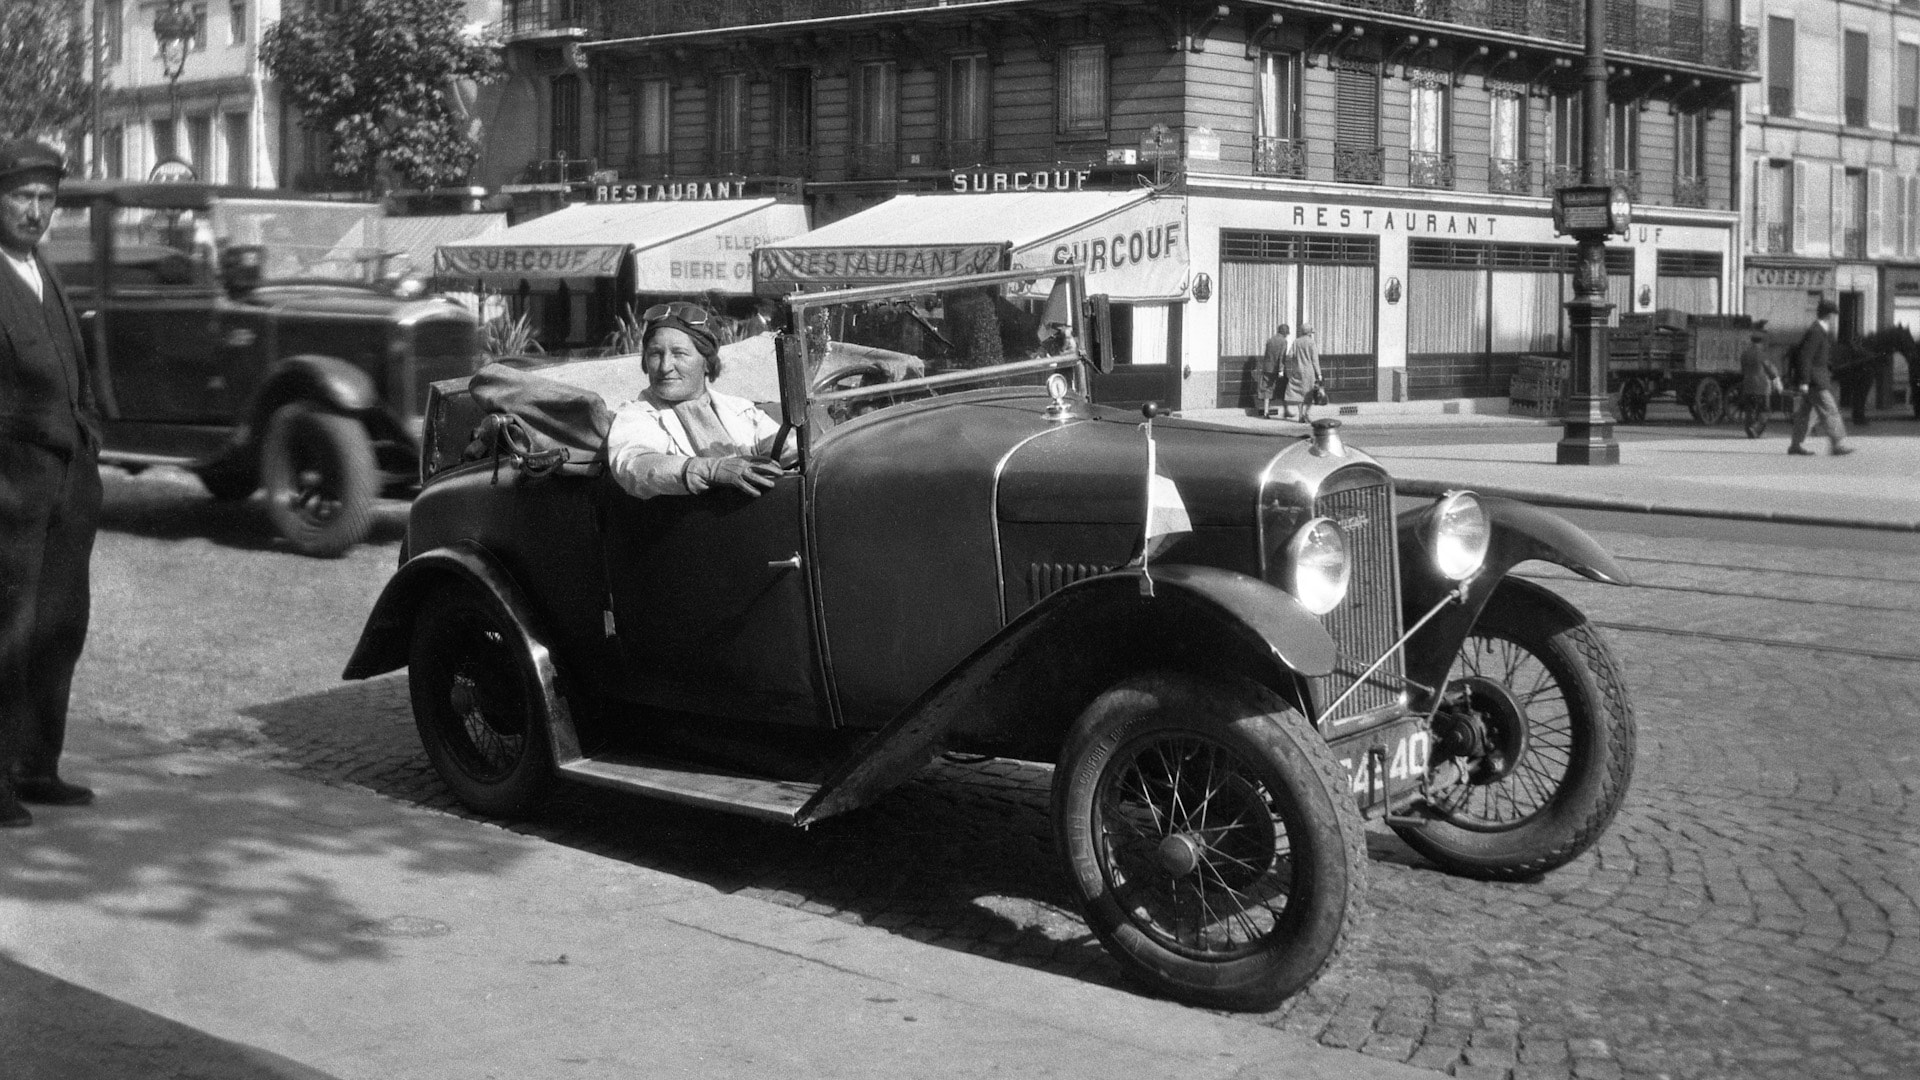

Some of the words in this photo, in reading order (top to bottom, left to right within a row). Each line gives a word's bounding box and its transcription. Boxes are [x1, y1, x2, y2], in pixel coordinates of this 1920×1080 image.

[597, 181, 746, 202] RESTAURANT
[953, 169, 1091, 193] SURCOUF
[1293, 206, 1498, 236] RESTAURANT
[1053, 220, 1181, 275] SURCOUF
[468, 249, 588, 271] SURCOUF
[670, 261, 728, 280] BIERE
[793, 250, 962, 275] RESTAURANT
